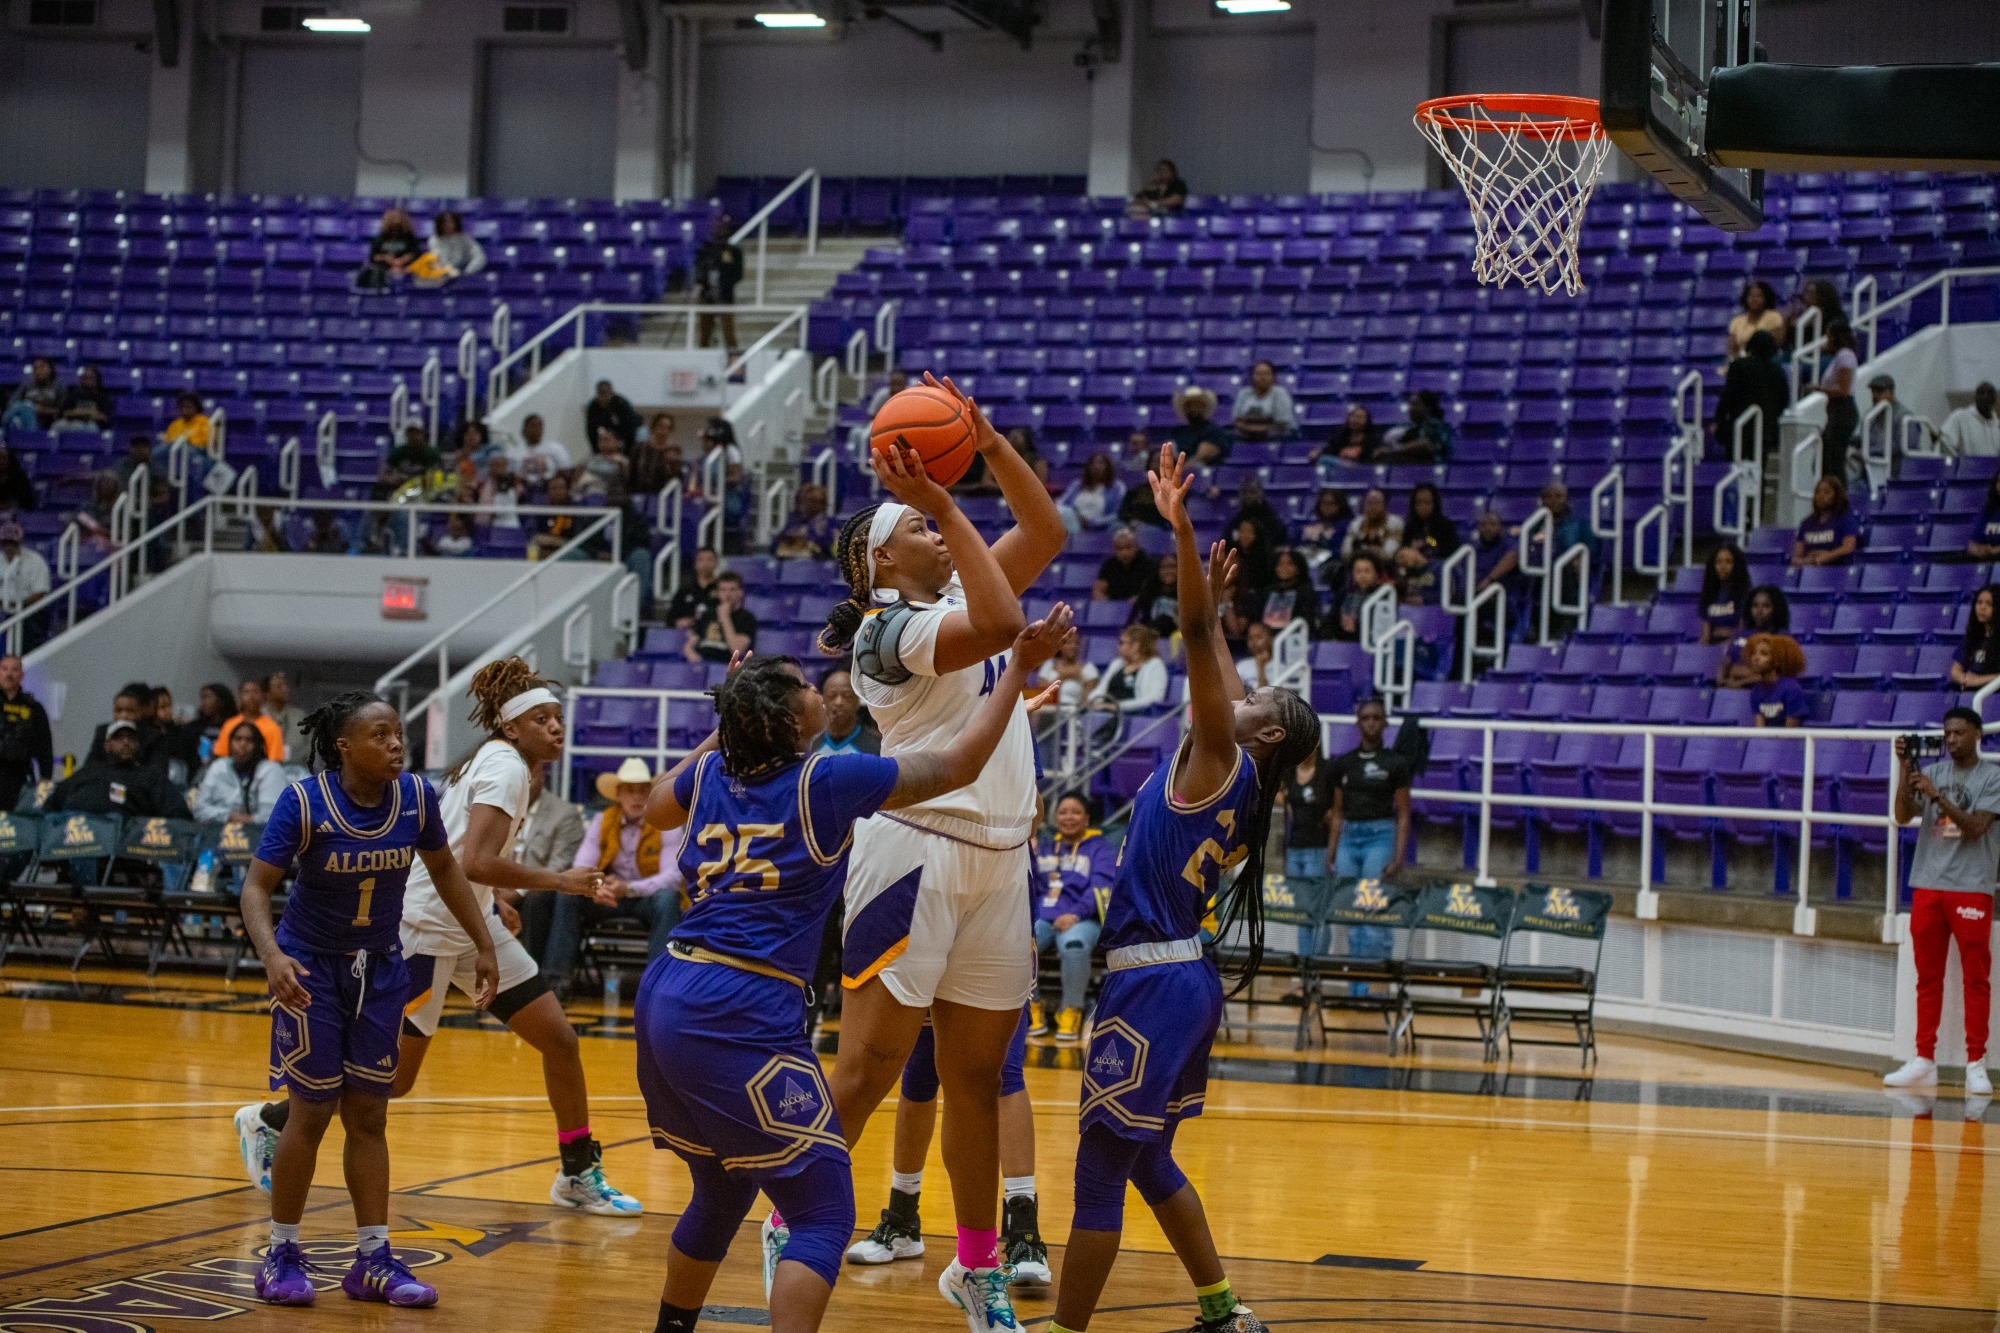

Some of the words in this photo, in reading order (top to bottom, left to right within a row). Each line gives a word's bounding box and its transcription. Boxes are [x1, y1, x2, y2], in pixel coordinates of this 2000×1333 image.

[324, 845, 412, 873] ALCORN
[693, 822, 784, 902] 25
[351, 877, 376, 927] 1
[1093, 1056, 1125, 1067] ALCORN
[778, 1091, 814, 1108] ALCORN
